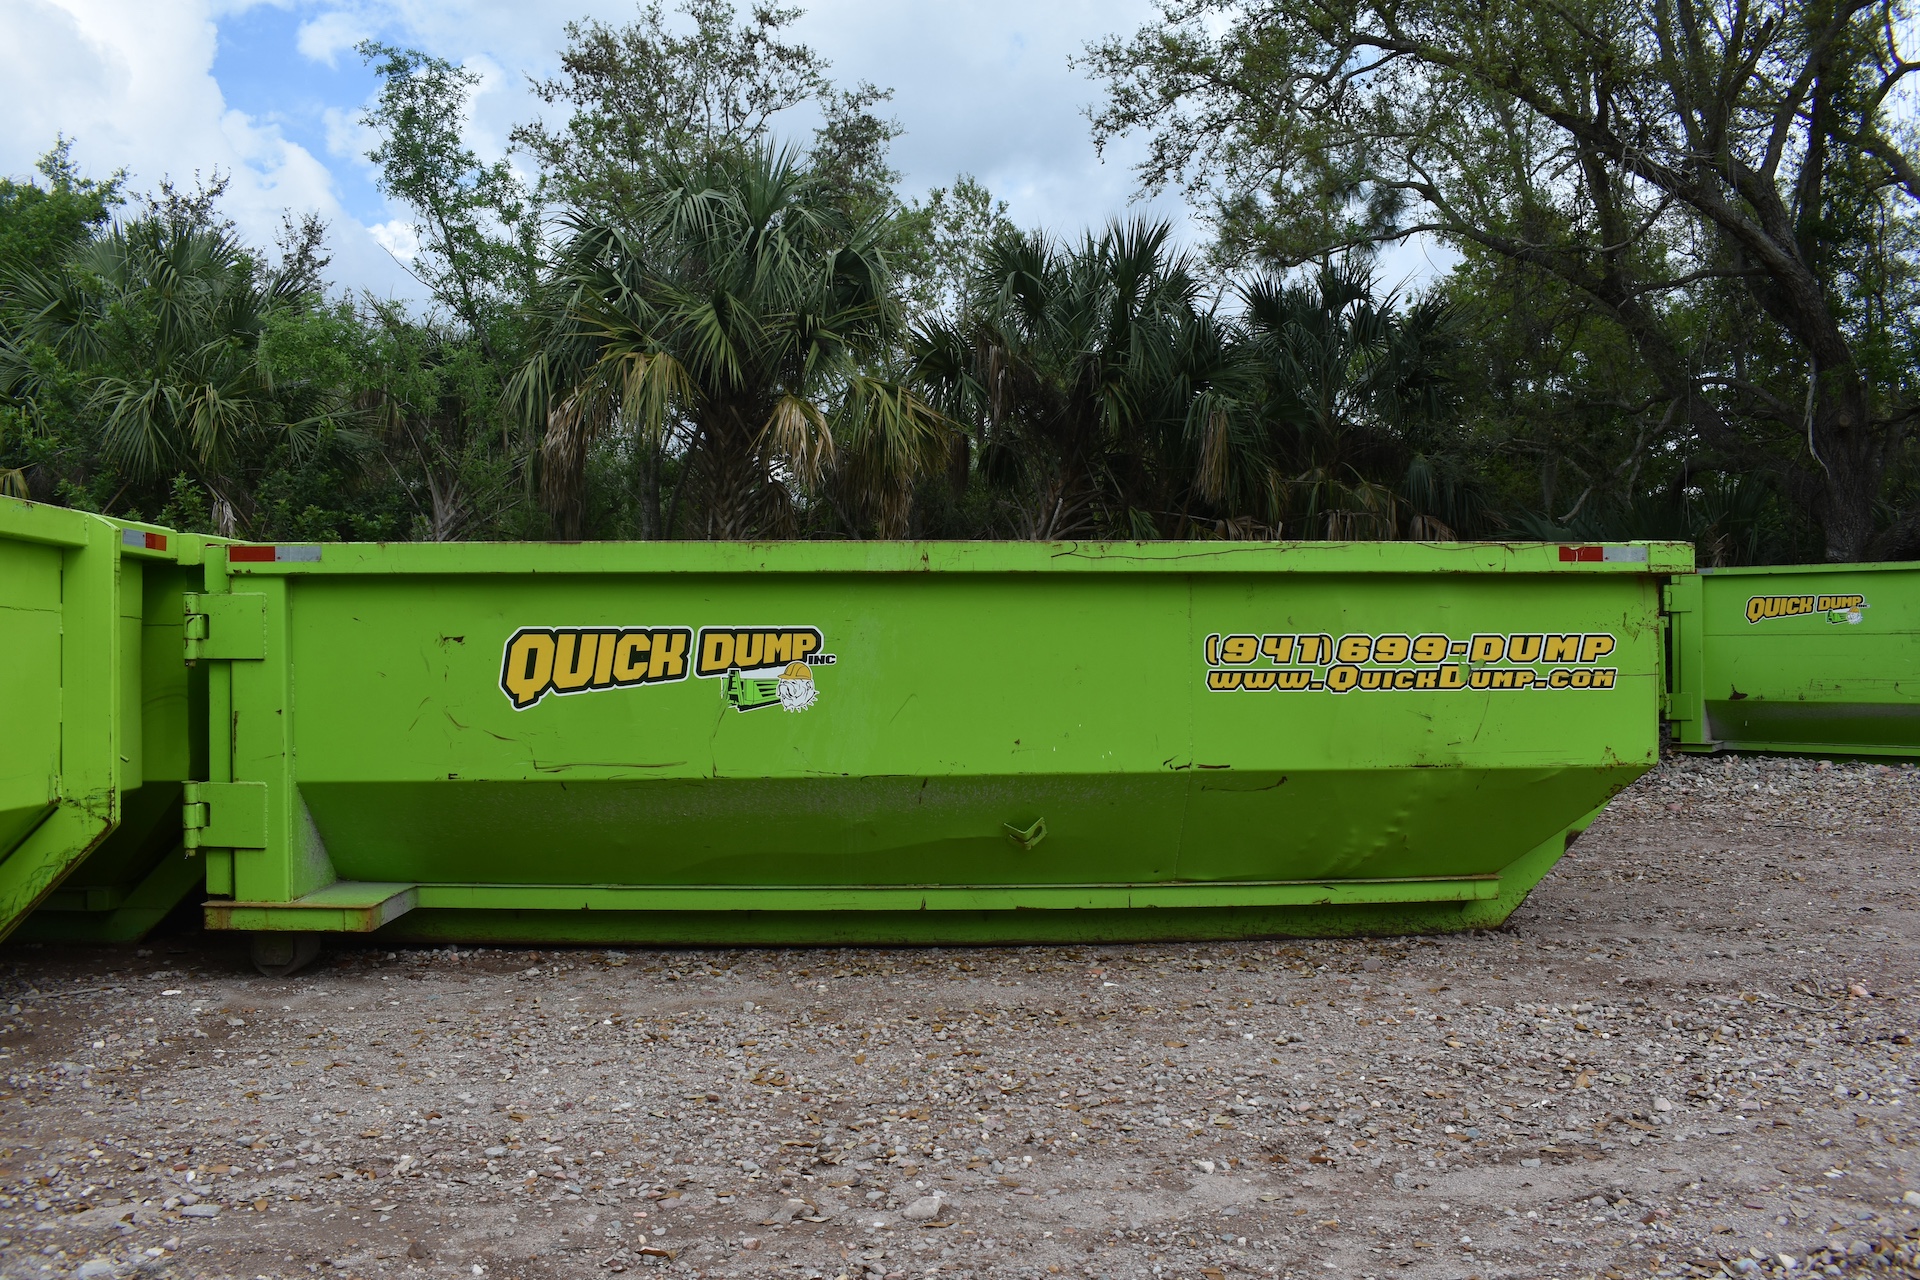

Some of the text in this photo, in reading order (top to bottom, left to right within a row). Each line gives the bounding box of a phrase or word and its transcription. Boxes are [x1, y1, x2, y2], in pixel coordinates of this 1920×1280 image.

[1746, 596, 1863, 623] QUICK DUMP
[1206, 634, 1616, 664] (941)699-DUMP
[503, 629, 836, 708] QUICK DUMP INC
